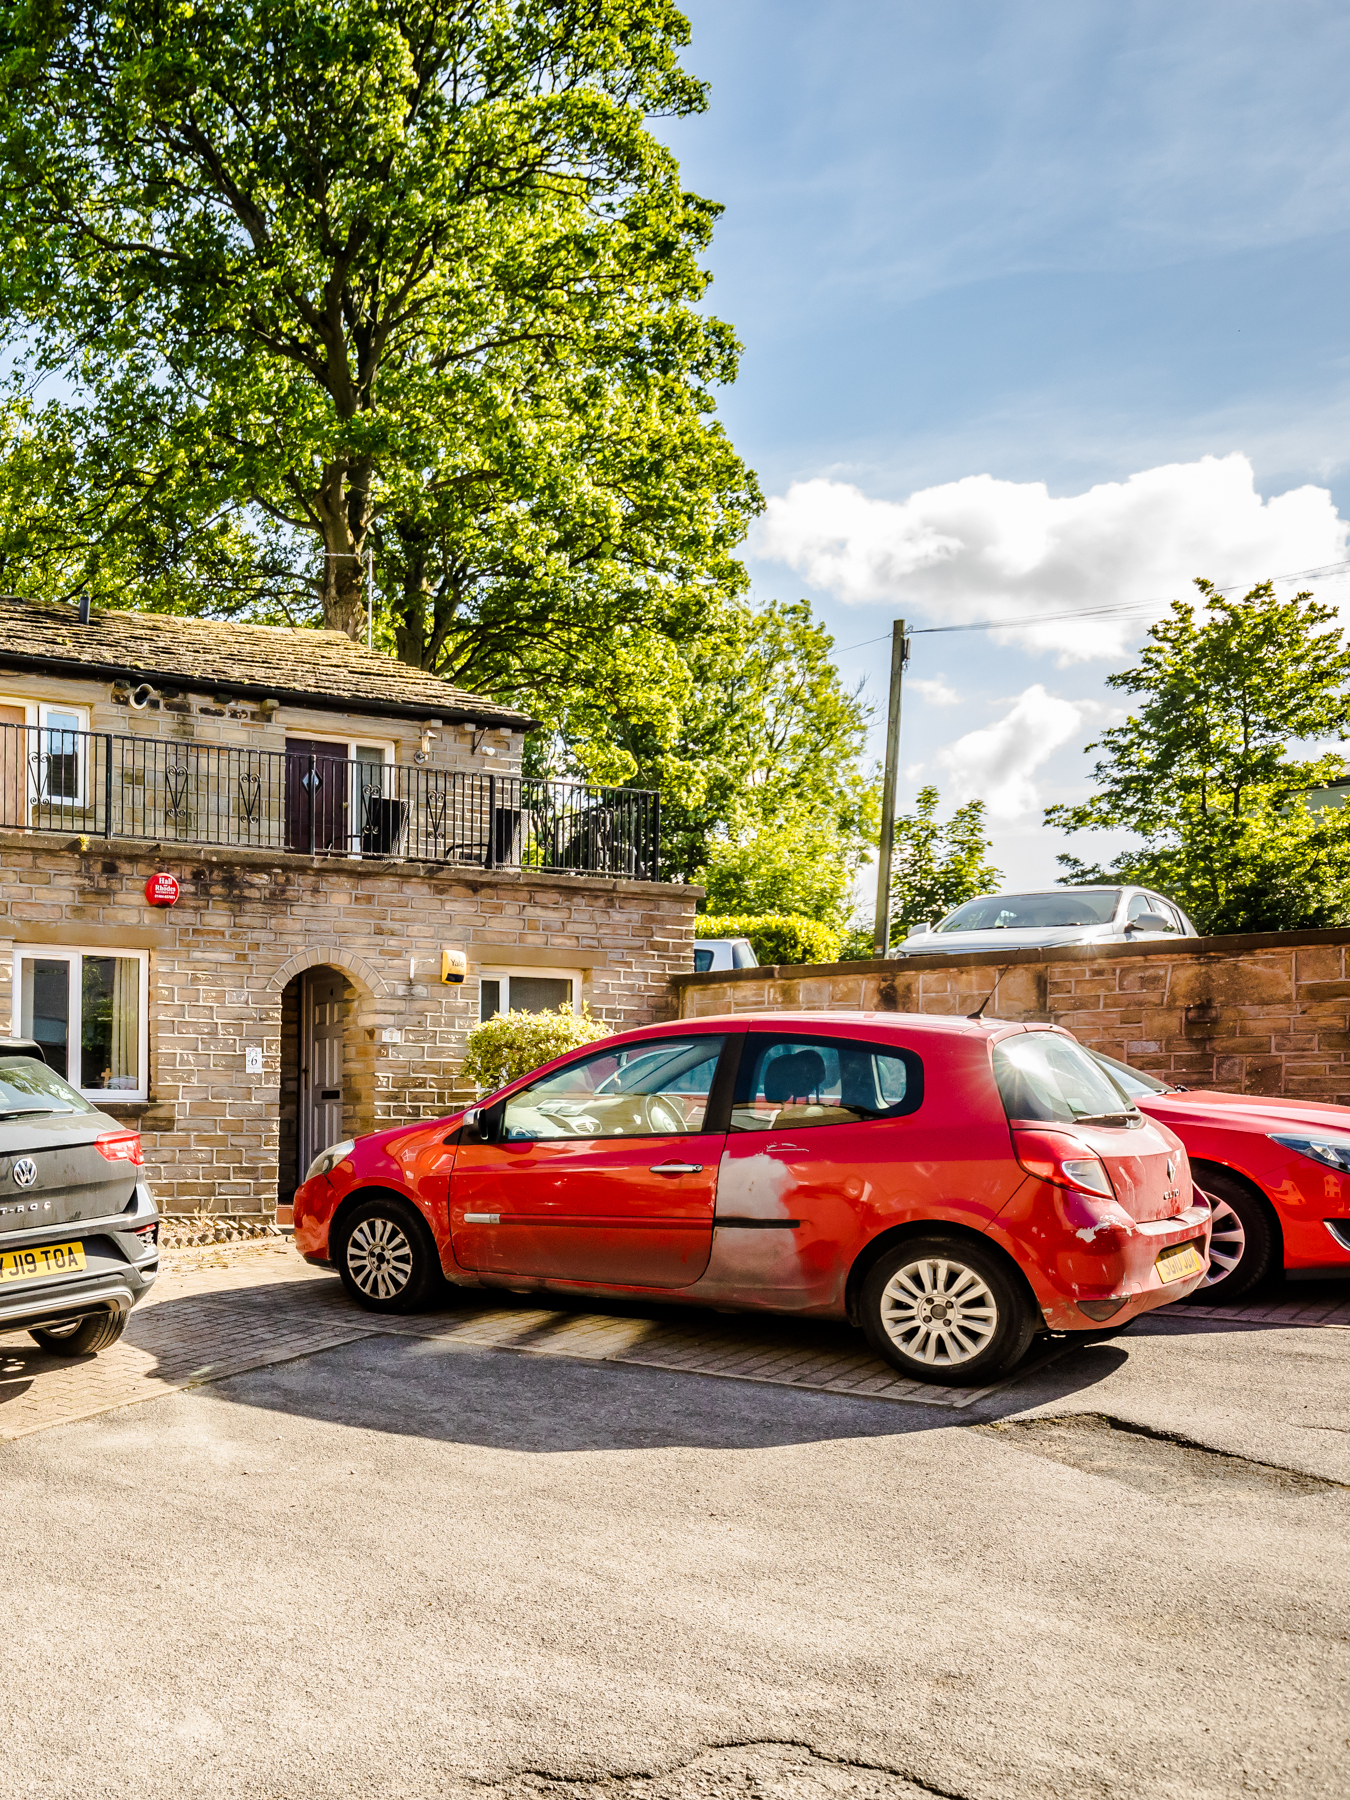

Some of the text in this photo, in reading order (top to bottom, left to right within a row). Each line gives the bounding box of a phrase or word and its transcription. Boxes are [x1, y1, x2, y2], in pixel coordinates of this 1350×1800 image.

[158, 877, 173, 885] Hall
[450, 958, 465, 967] Yale
[251, 1055, 258, 1066] 6
[40, 1246, 78, 1271] TOA
